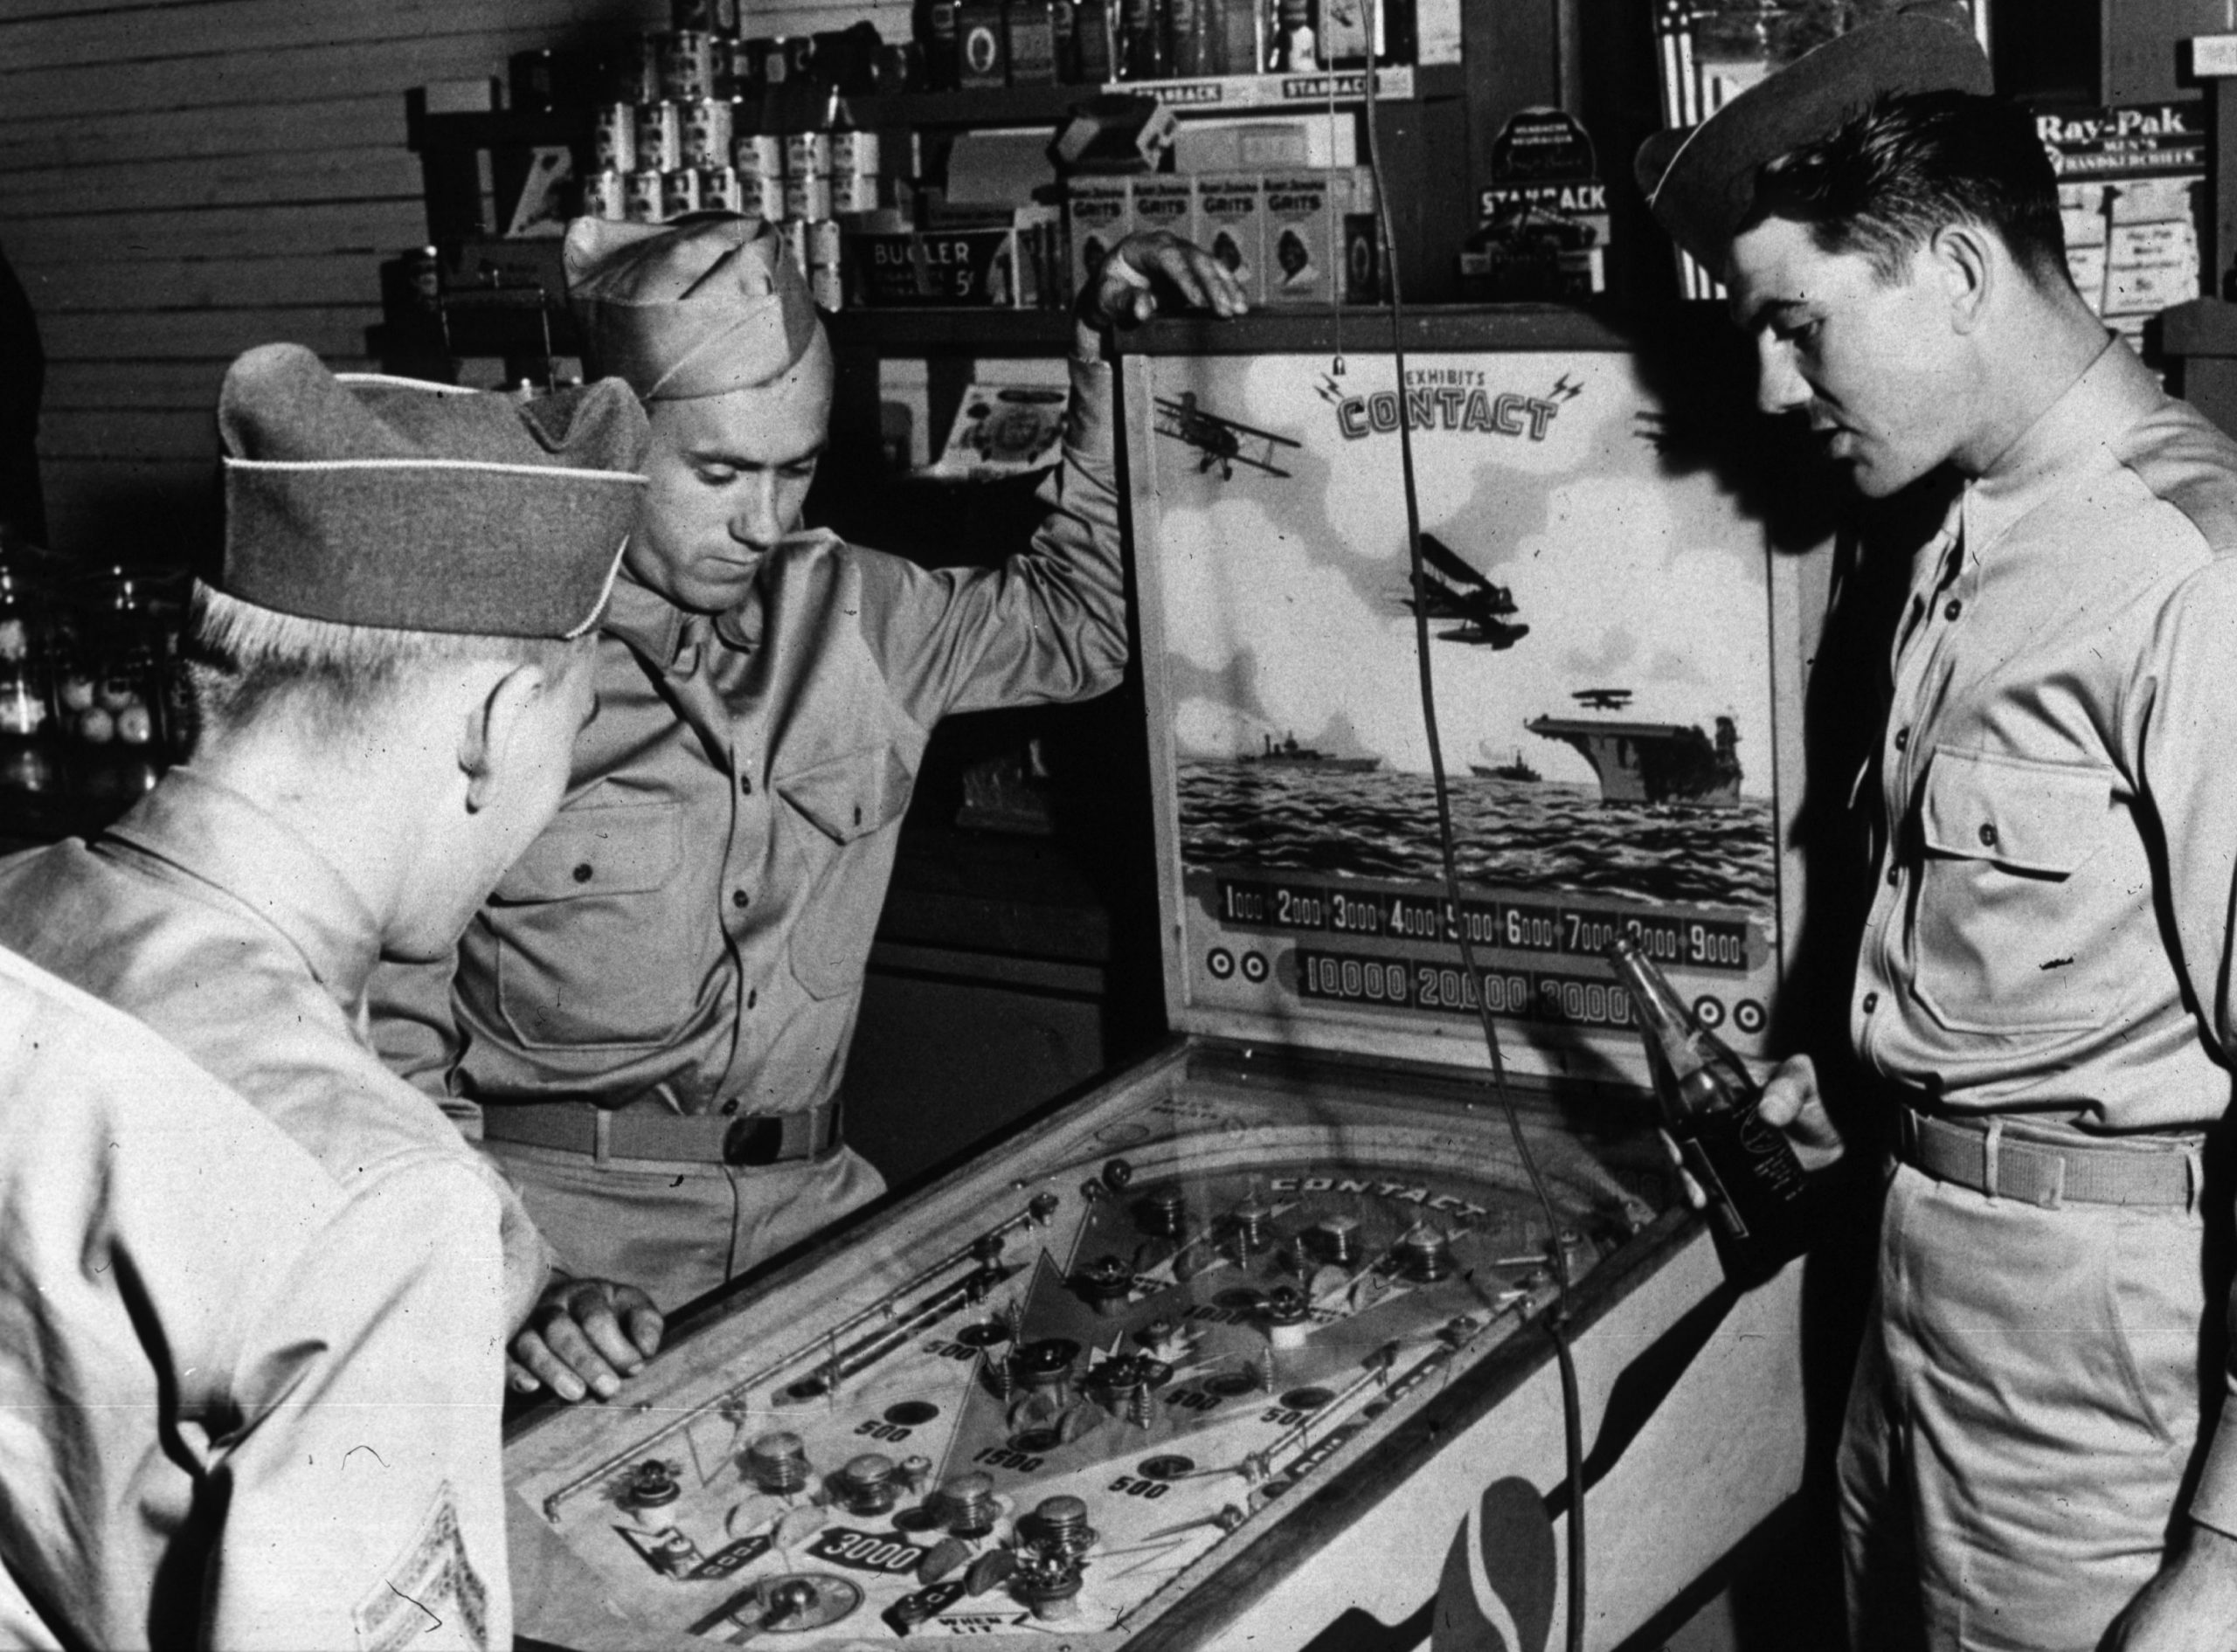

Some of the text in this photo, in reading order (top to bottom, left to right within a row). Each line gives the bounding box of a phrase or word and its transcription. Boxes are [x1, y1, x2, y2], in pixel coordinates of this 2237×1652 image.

[1287, 78, 1368, 96] STANBAC
[2036, 107, 2186, 146] Ray-Pak
[1405, 370, 1486, 387] EXHIBITS
[1336, 387, 1560, 442] CONTACT
[1227, 884, 1264, 920] 1000
[1278, 888, 1321, 926] 2000
[1333, 894, 1378, 931] 3000
[1390, 899, 1436, 937] 4000
[1506, 909, 1553, 947] 6000
[1690, 924, 1741, 965] 9000
[1307, 956, 1407, 1001] 10,000
[922, 1339, 979, 1361] 500
[854, 1420, 913, 1443] 500
[972, 1448, 1045, 1473] 1500
[1108, 1476, 1171, 1500] 500
[824, 1532, 922, 1570] 3000
[937, 1616, 1002, 1628] WHEN
[950, 1625, 993, 1635] LIT
